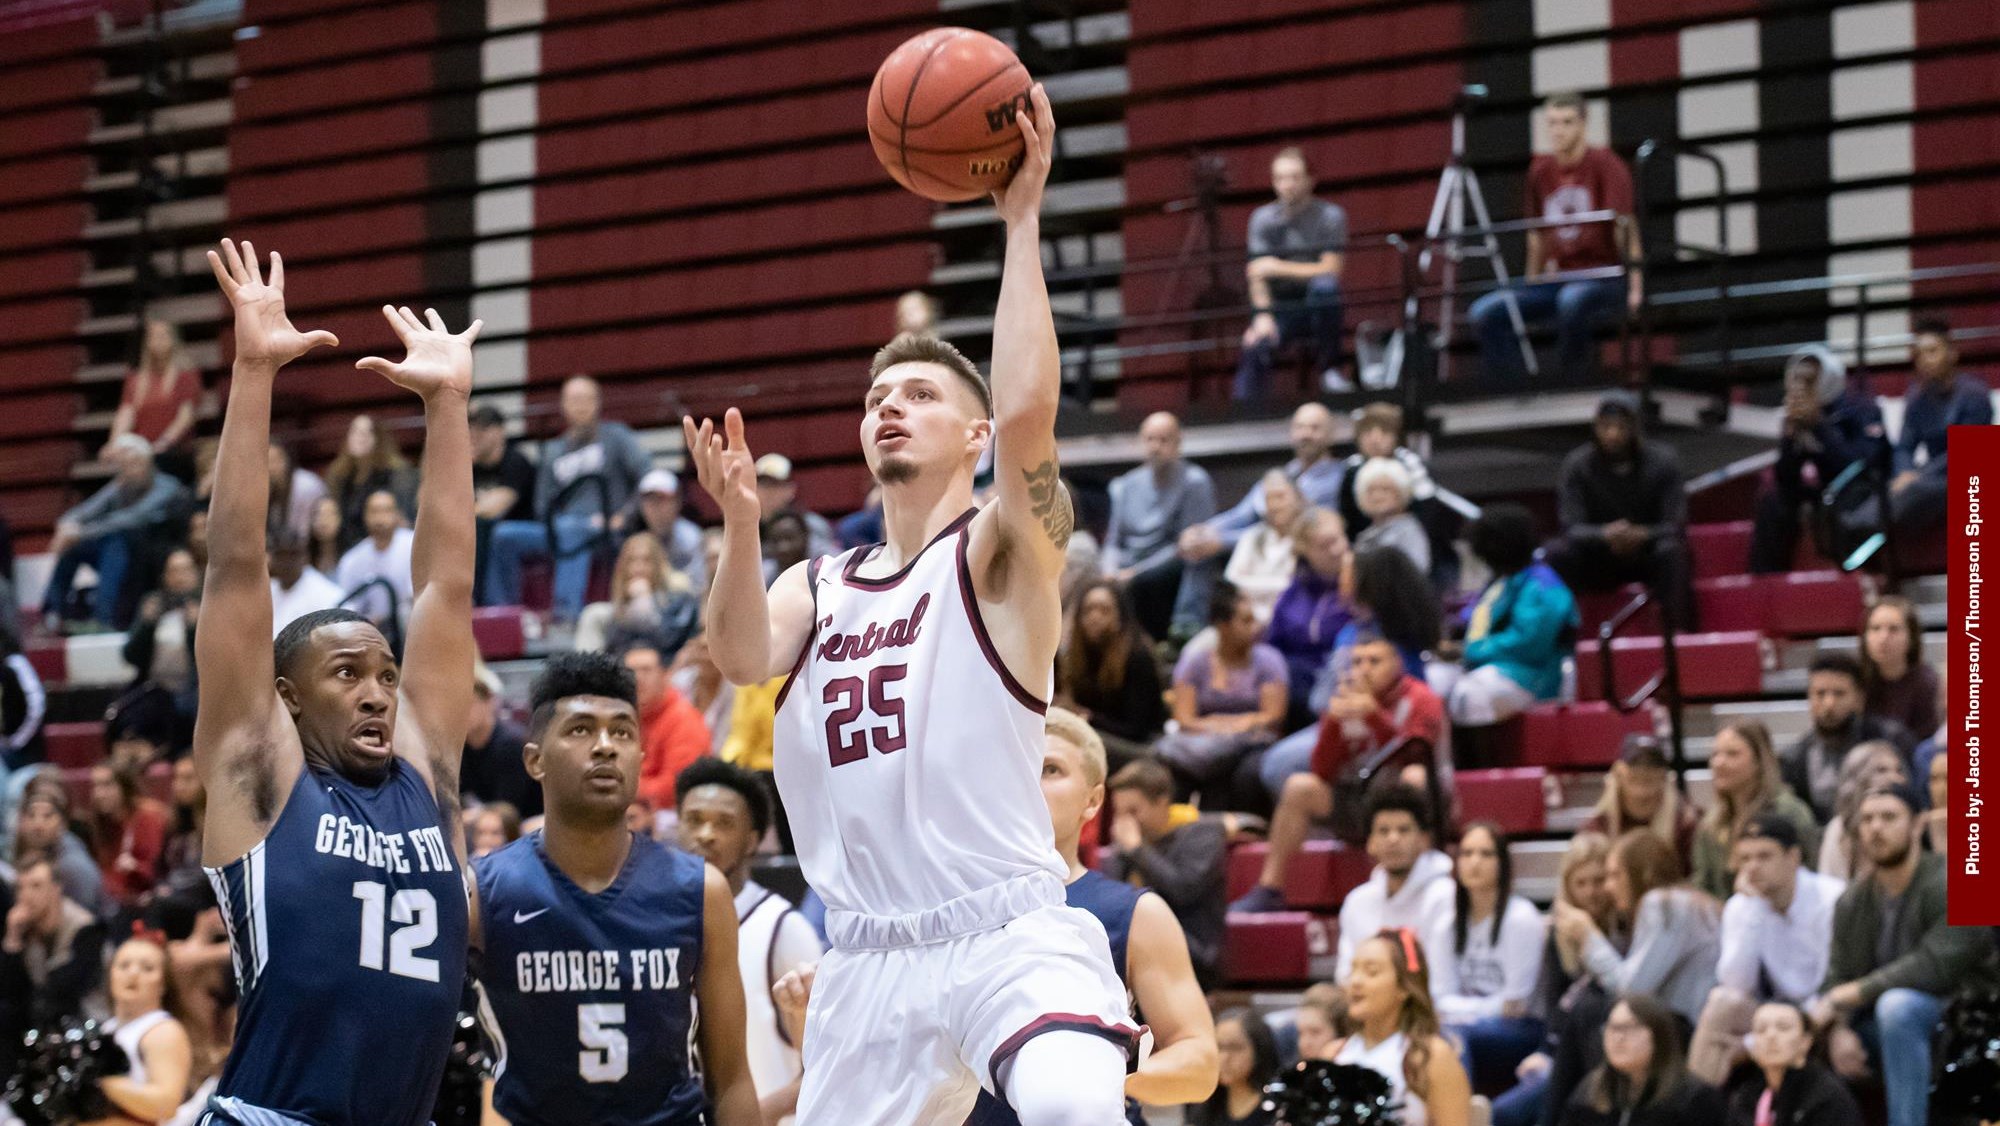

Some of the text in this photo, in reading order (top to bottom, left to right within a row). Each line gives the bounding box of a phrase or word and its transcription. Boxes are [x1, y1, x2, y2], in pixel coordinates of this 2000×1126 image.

[823, 663, 908, 768] 25
[315, 813, 453, 874] GEORGE FOX
[352, 881, 440, 982] 12
[516, 947, 680, 993] GEORGE FOX
[577, 1003, 629, 1083] 5
